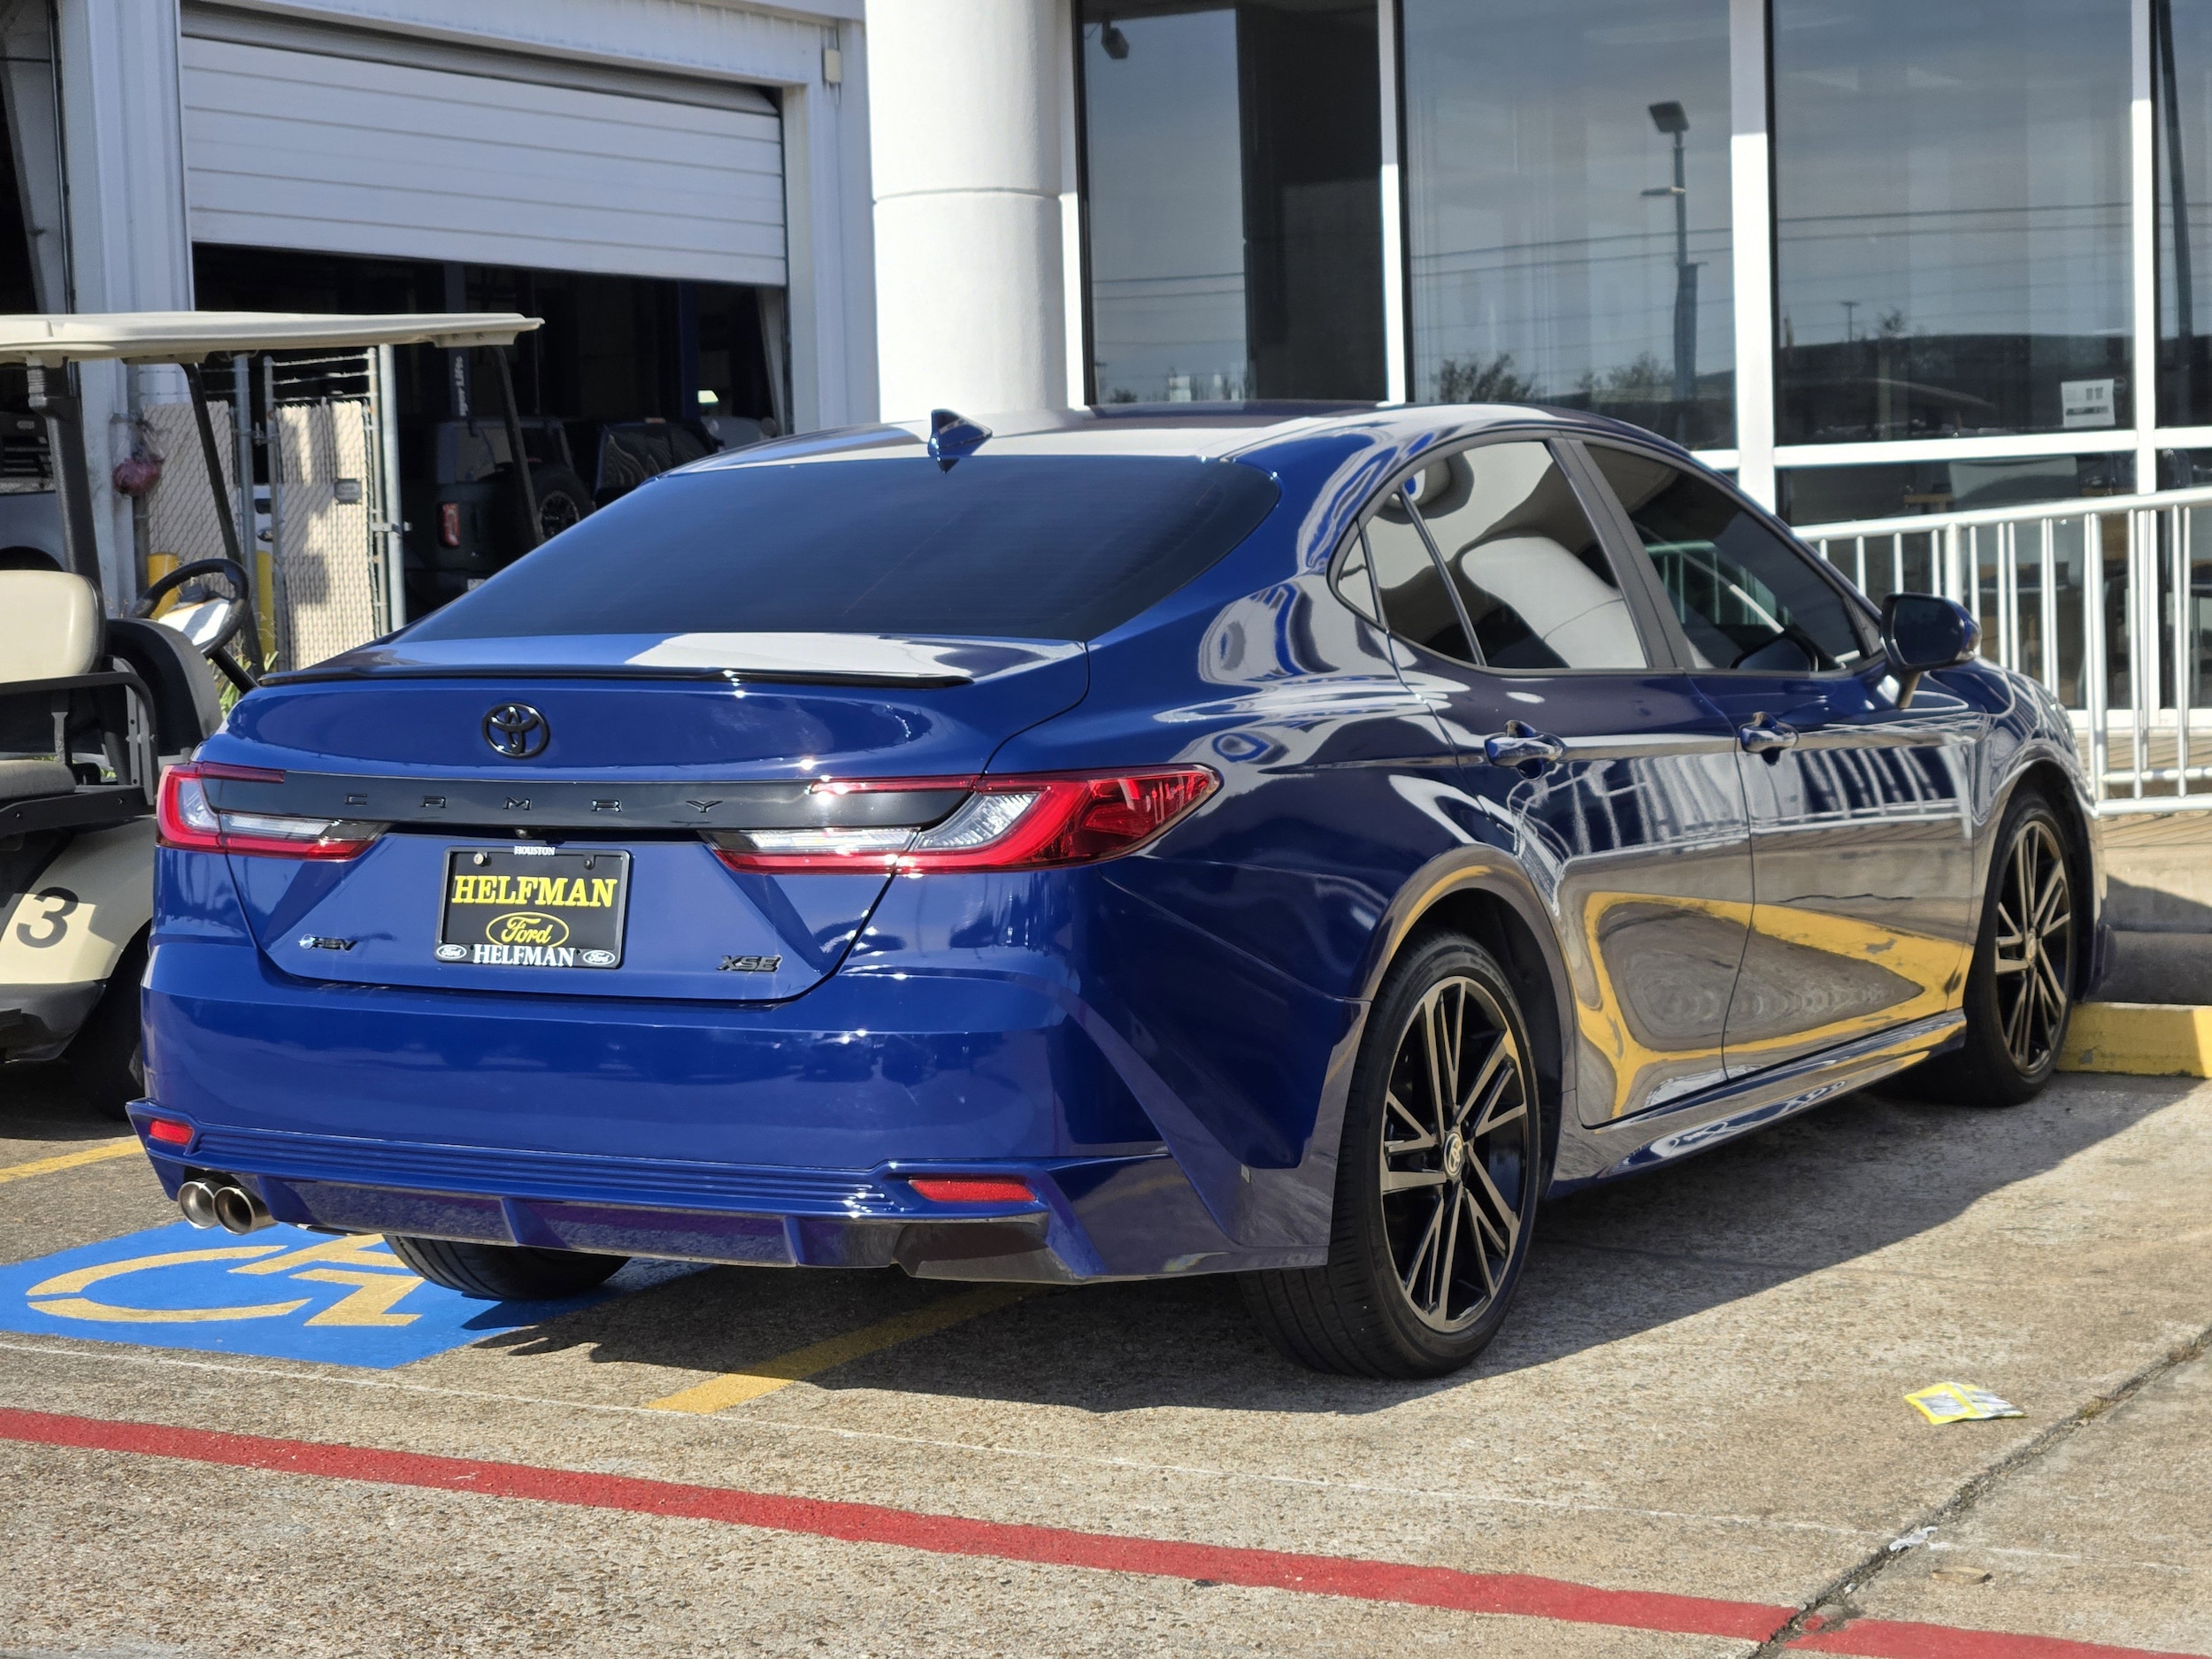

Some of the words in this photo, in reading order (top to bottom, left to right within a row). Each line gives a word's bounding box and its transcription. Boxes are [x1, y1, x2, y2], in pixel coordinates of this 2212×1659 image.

[343, 792, 724, 814] CAMRY
[513, 845, 557, 856] HOUSTON
[450, 874, 618, 908] HELFMAN
[15, 886, 81, 949] 3
[500, 915, 555, 944] Ford
[442, 946, 462, 956] Ford
[472, 943, 576, 967] HELFMAN
[588, 951, 611, 963] Ford
[716, 954, 783, 972] XSE
